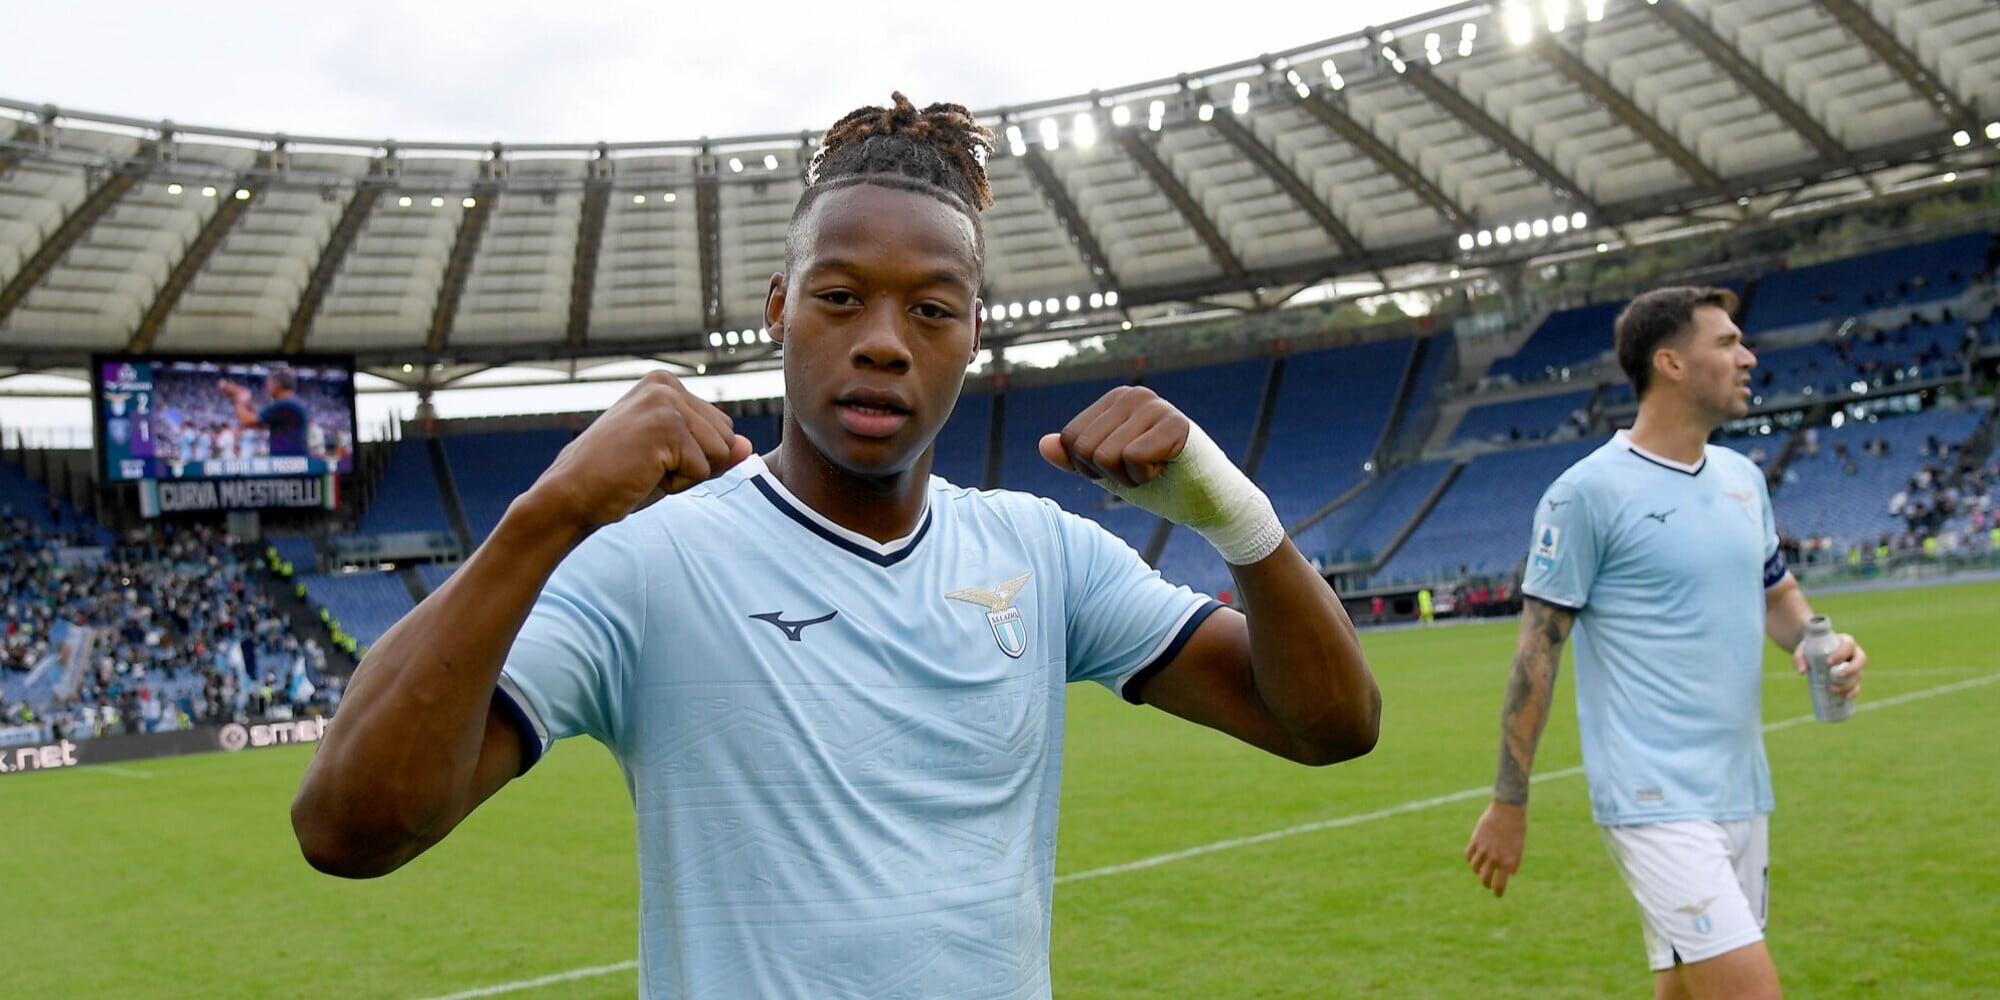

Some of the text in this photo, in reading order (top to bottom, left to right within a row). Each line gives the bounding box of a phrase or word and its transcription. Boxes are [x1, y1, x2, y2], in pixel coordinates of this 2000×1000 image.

[137, 393, 149, 414] 2
[139, 420, 149, 442] 1
[159, 478, 321, 511] CURVA MAESTRELLI
